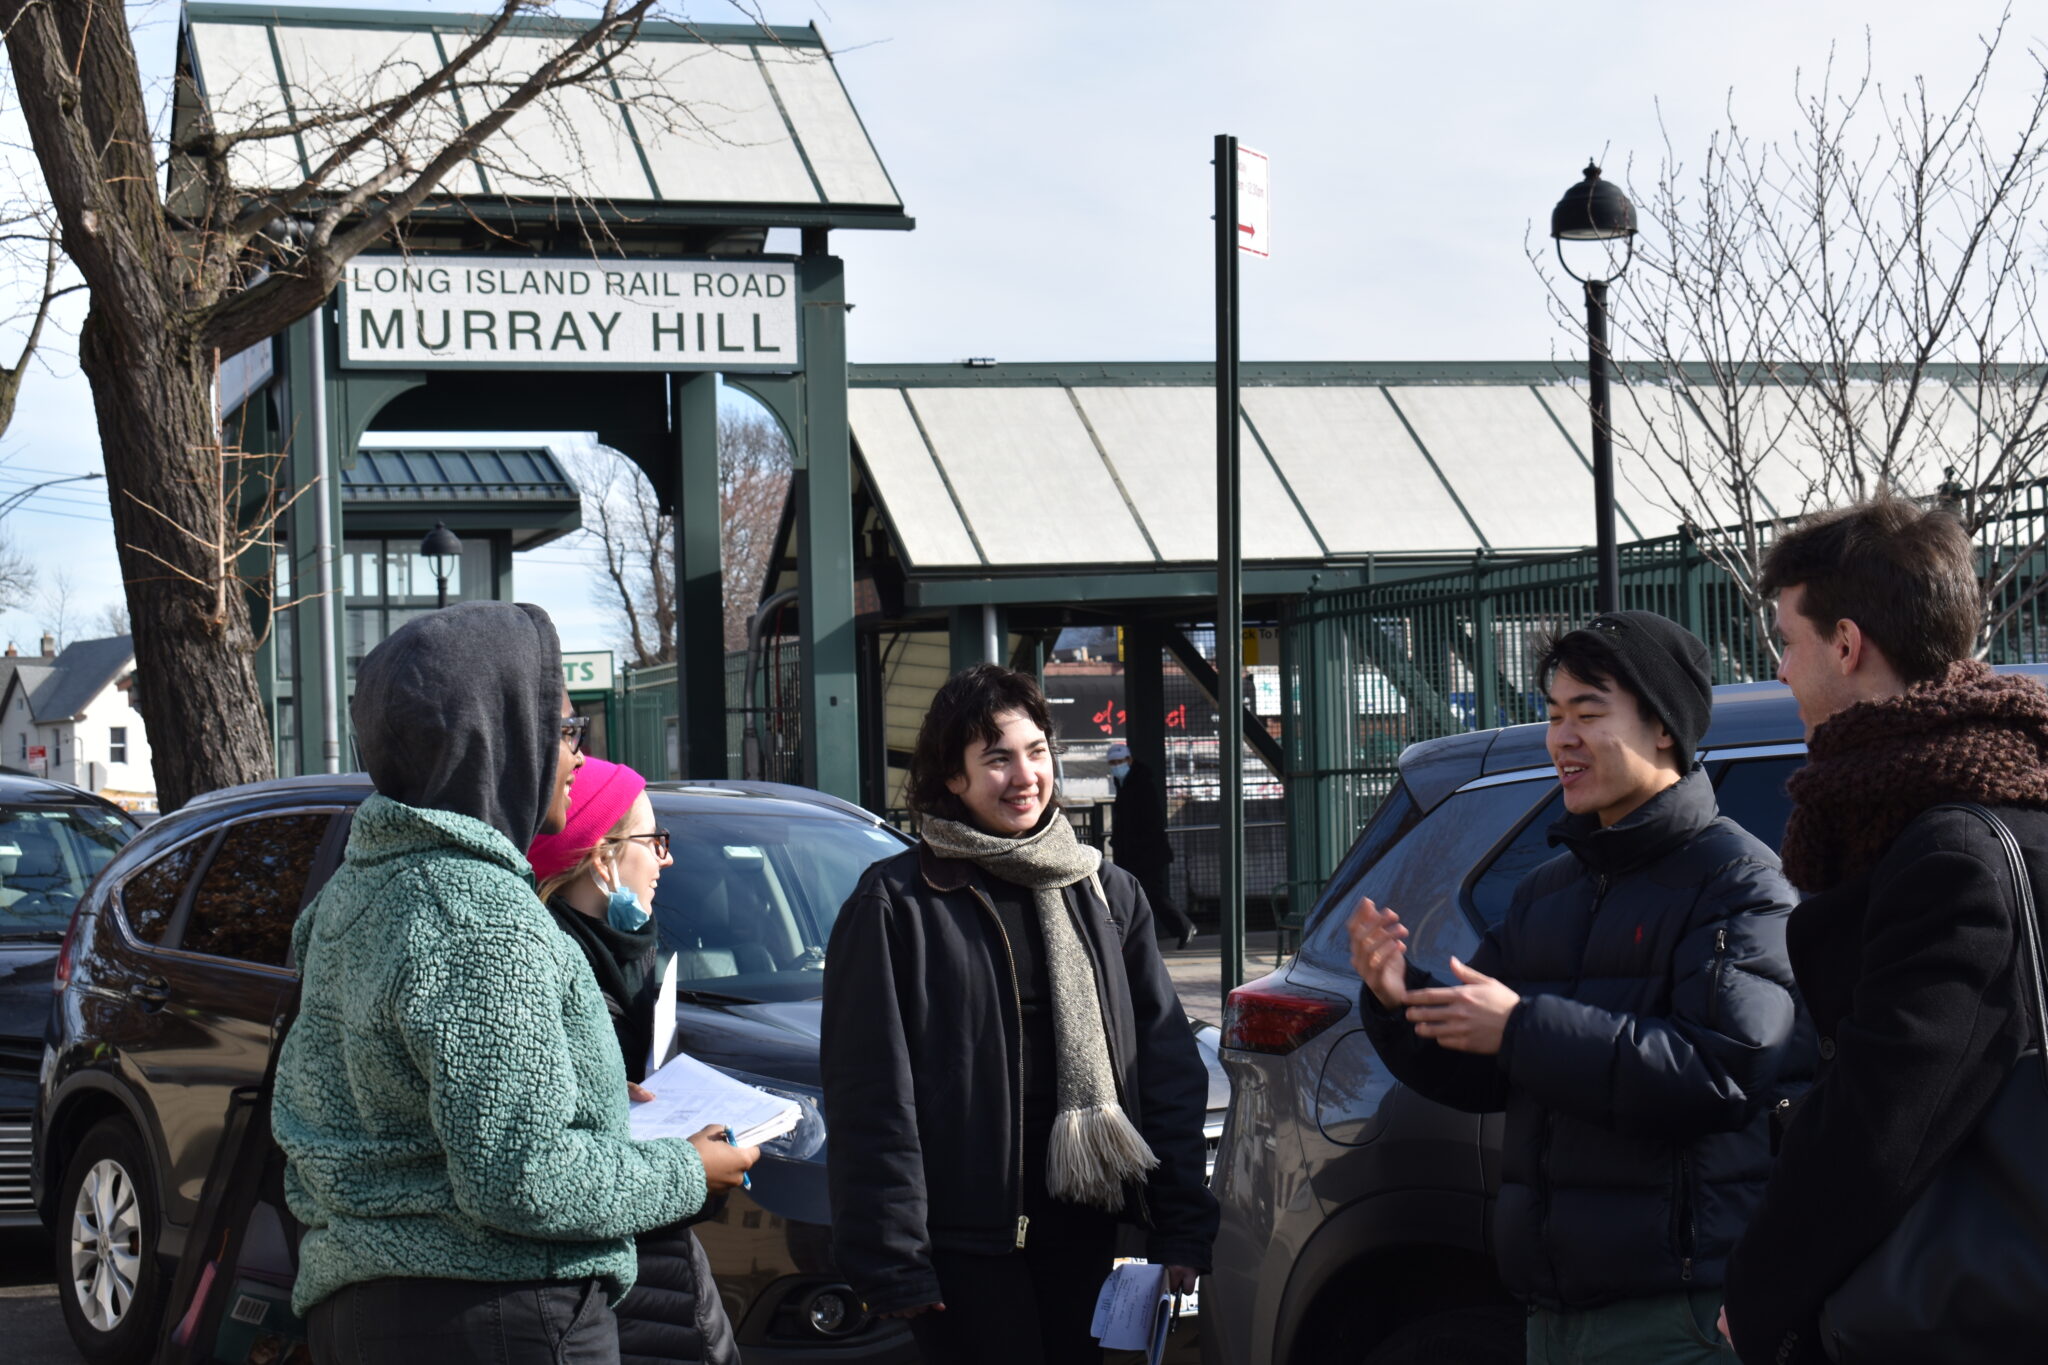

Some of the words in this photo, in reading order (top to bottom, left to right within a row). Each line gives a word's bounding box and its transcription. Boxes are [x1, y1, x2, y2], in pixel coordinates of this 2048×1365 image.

[354, 267, 450, 294] LONG
[466, 269, 591, 295] ISLAND
[605, 271, 680, 297] RAIL
[694, 272, 786, 298] ROAD
[361, 308, 622, 351] MURRAY
[652, 311, 781, 352] HILL
